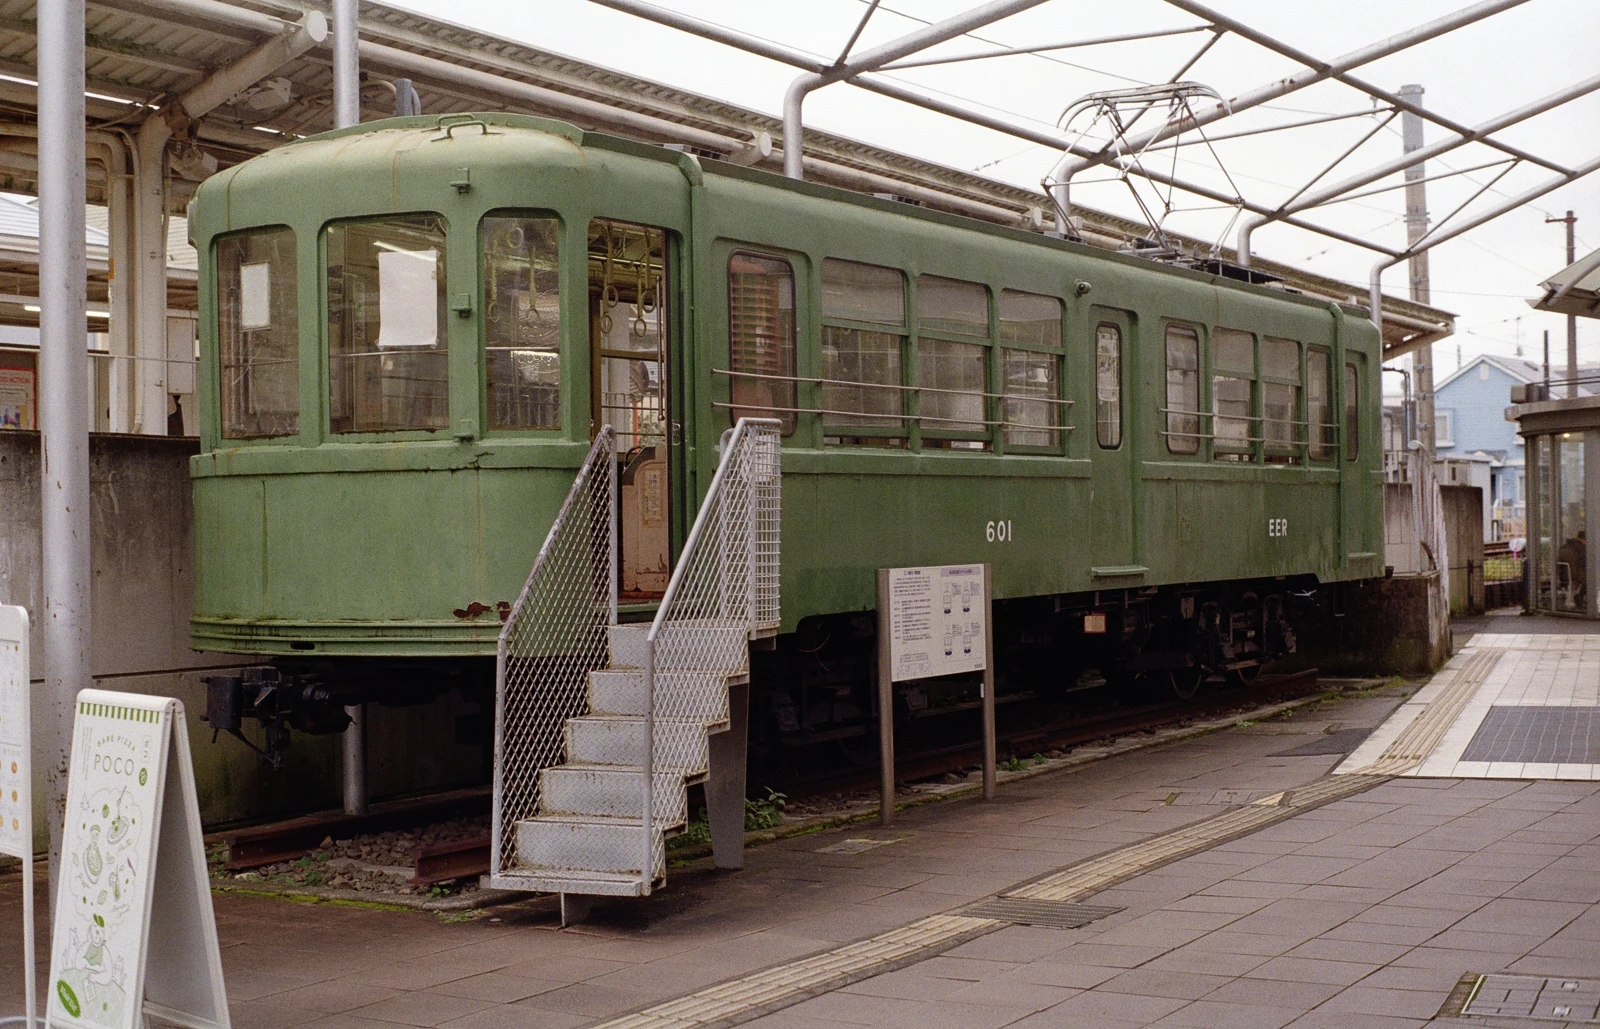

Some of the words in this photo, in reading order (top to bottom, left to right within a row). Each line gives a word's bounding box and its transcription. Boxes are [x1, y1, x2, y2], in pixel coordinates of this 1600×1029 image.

[986, 520, 1012, 542] 601
[1269, 518, 1288, 537] EER
[117, 735, 136, 752] PIZZA
[94, 754, 135, 776] POCO
